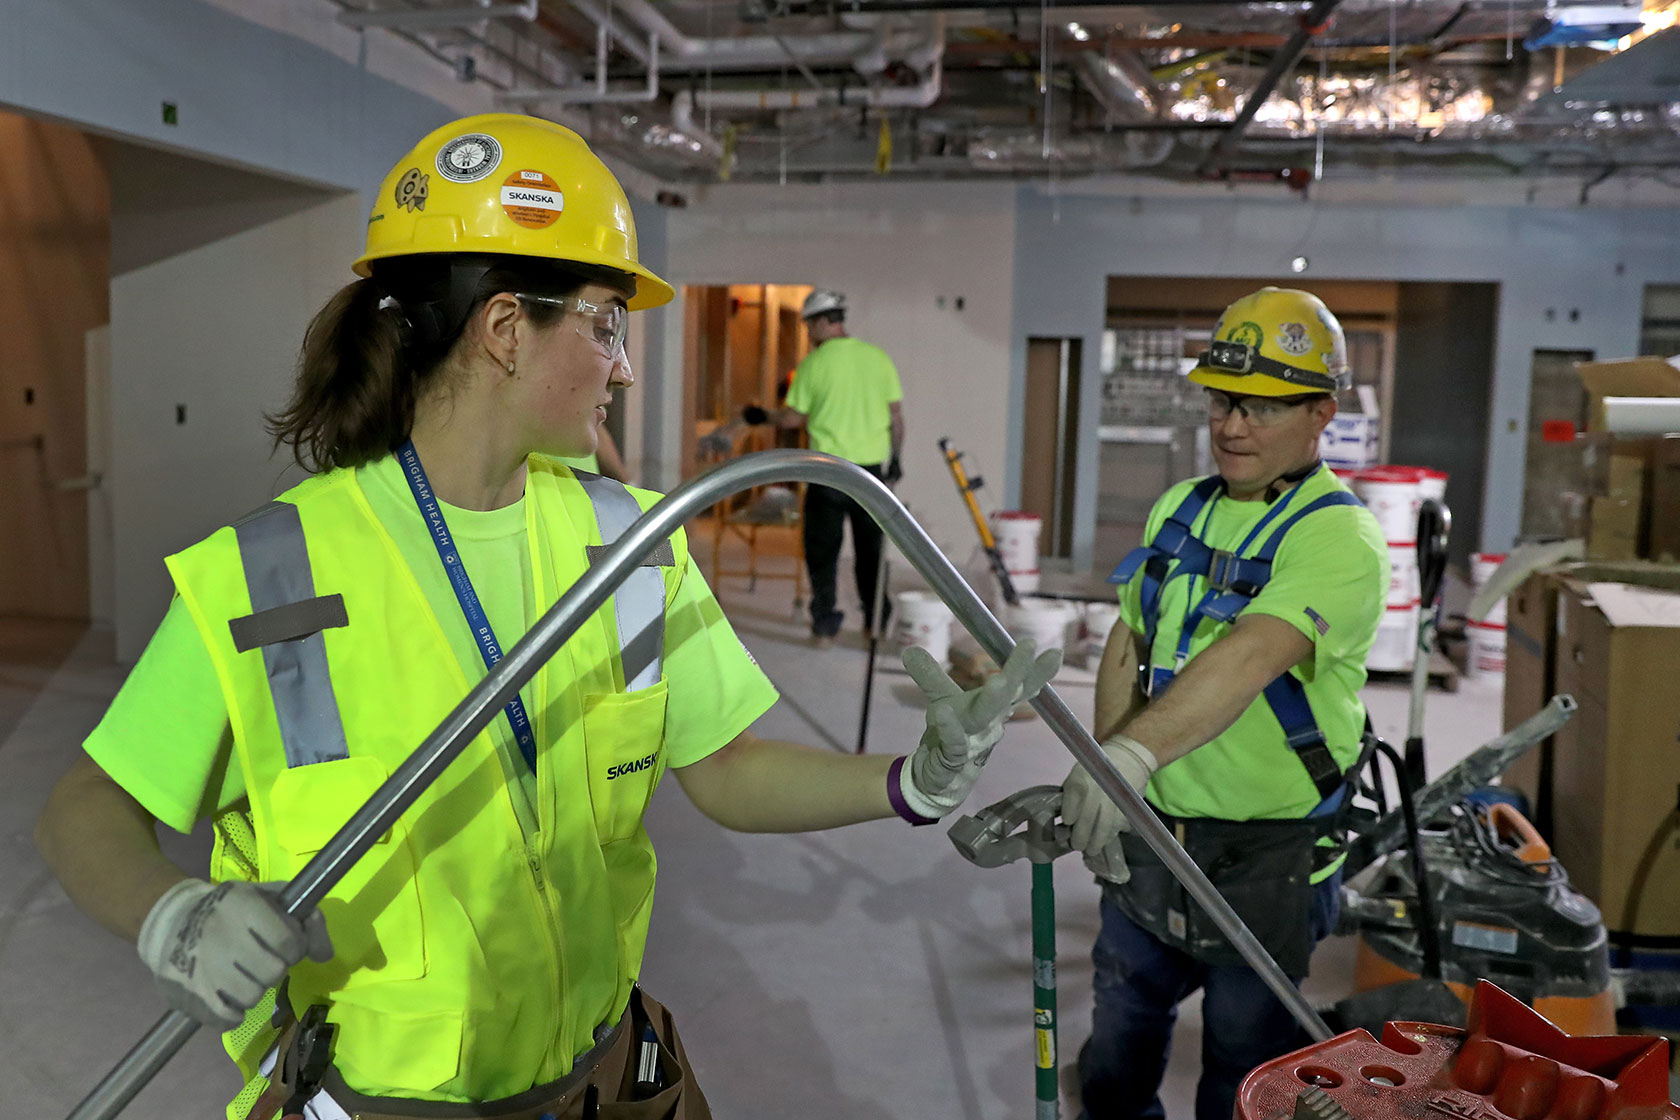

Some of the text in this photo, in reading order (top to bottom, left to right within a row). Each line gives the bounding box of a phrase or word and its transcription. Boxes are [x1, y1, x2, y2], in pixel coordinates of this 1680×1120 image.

[508, 191, 554, 204] SKANSKA
[403, 449, 449, 546] BRIGHAM HEALTH
[479, 626, 526, 728] BRIGH ALTH
[606, 751, 658, 780] SKANSK
